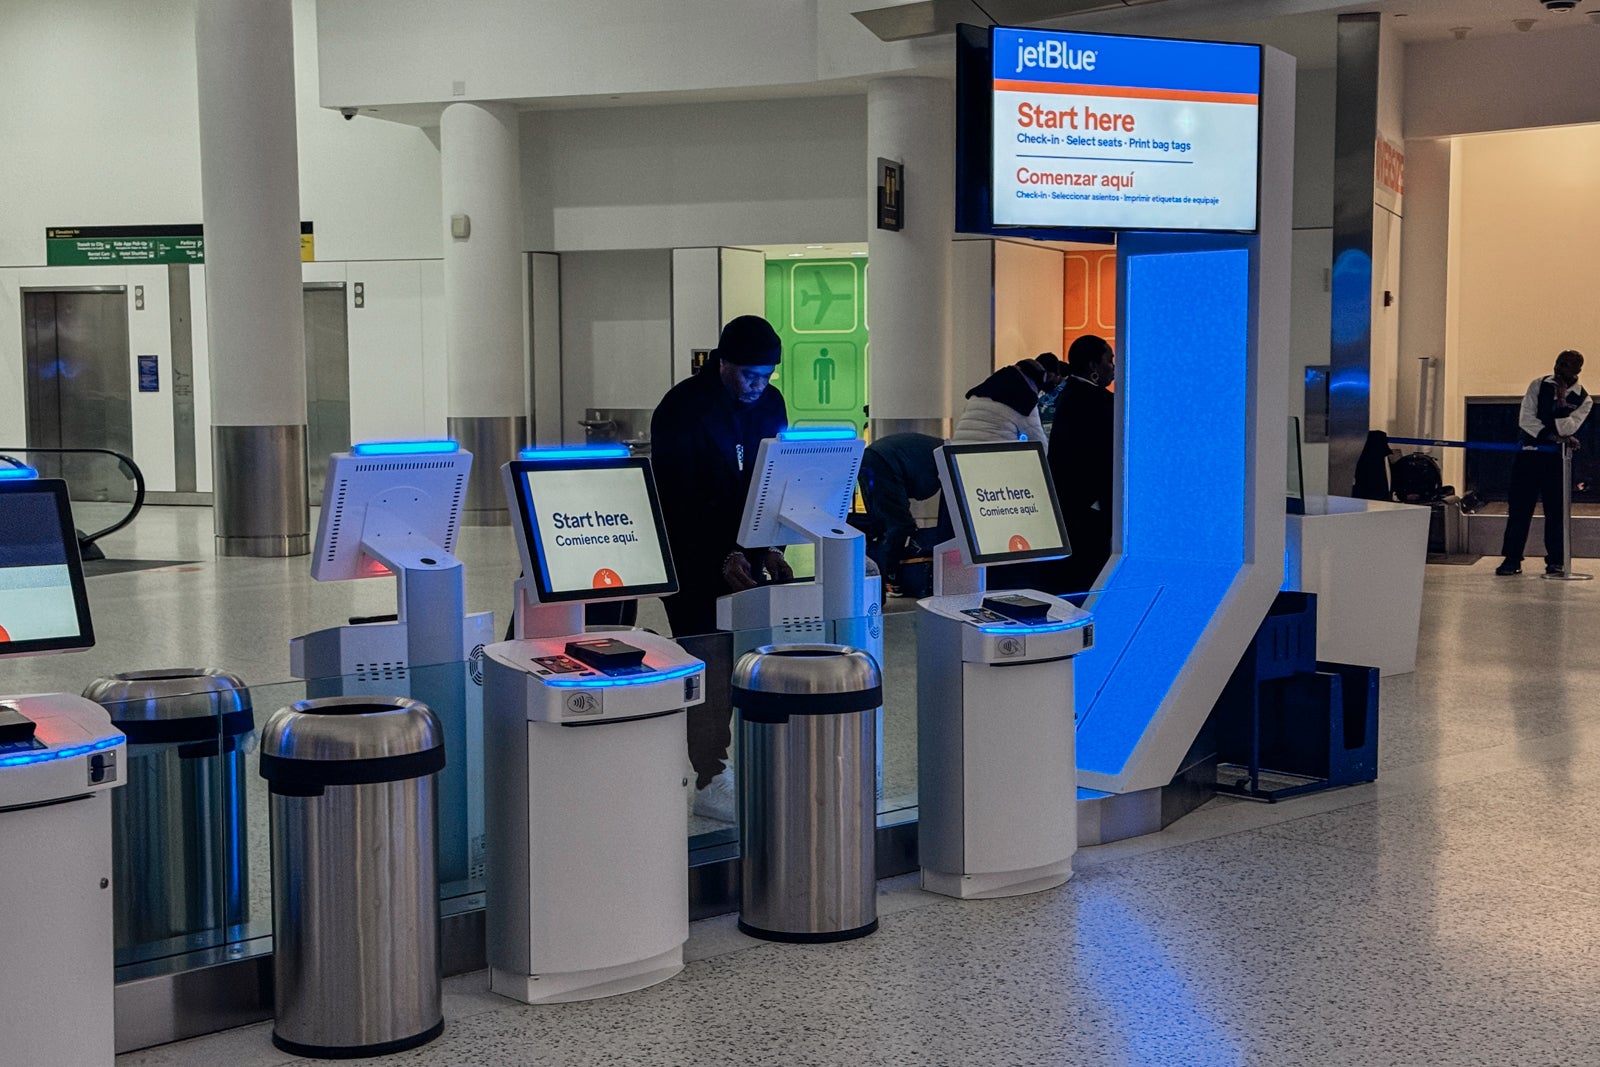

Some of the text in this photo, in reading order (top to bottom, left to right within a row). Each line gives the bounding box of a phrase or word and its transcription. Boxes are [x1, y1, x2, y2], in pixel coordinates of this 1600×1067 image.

[1015, 37, 1096, 73] jetBlue
[1017, 101, 1136, 133] Start here
[1016, 132, 1191, 153] Check-in Select seats Print bag tags
[1016, 167, 1135, 192] Comenzar aquí
[1016, 190, 1219, 206] Check-in Seleccionar asientos Imprimir etiquetas de equipaje
[976, 486, 1034, 502] Start here.
[553, 511, 634, 529] Start here.
[980, 507, 1019, 516] Comience
[555, 531, 638, 547] Comience aquí.
